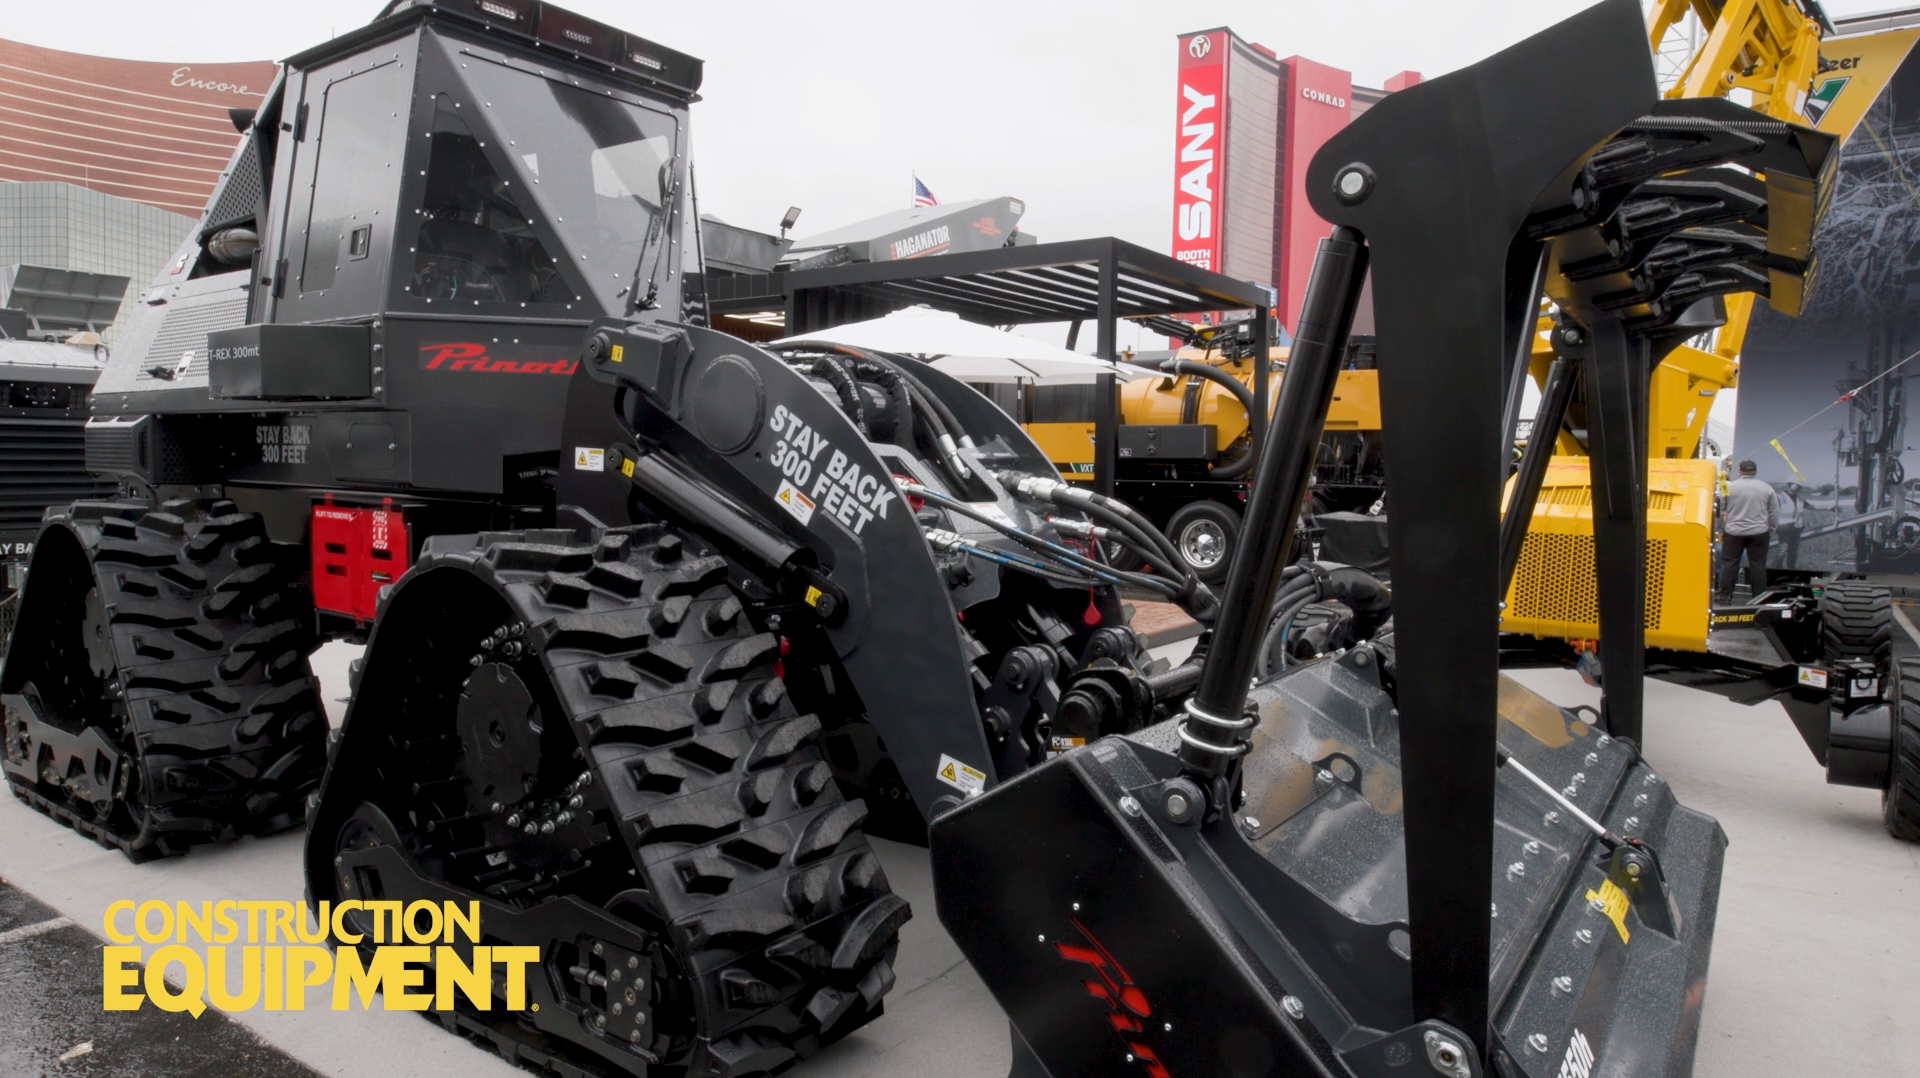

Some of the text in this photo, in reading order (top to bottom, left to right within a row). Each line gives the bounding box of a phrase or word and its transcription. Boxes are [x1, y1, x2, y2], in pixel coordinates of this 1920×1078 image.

[170, 66, 266, 97] Encore
[1302, 87, 1345, 108] CONRAD
[1178, 83, 1216, 241] SANY
[894, 225, 950, 260] HAGANATOR
[1176, 249, 1211, 261] BOOTH
[208, 345, 260, 361] T-REX 300mt
[255, 425, 311, 445] STAY BACK
[262, 444, 307, 464] 300 FEET
[769, 404, 898, 520] STAY BACK
[1080, 463, 1095, 473] VXT
[770, 439, 875, 535] 300 FEET
[1739, 614, 1755, 622] FEET
